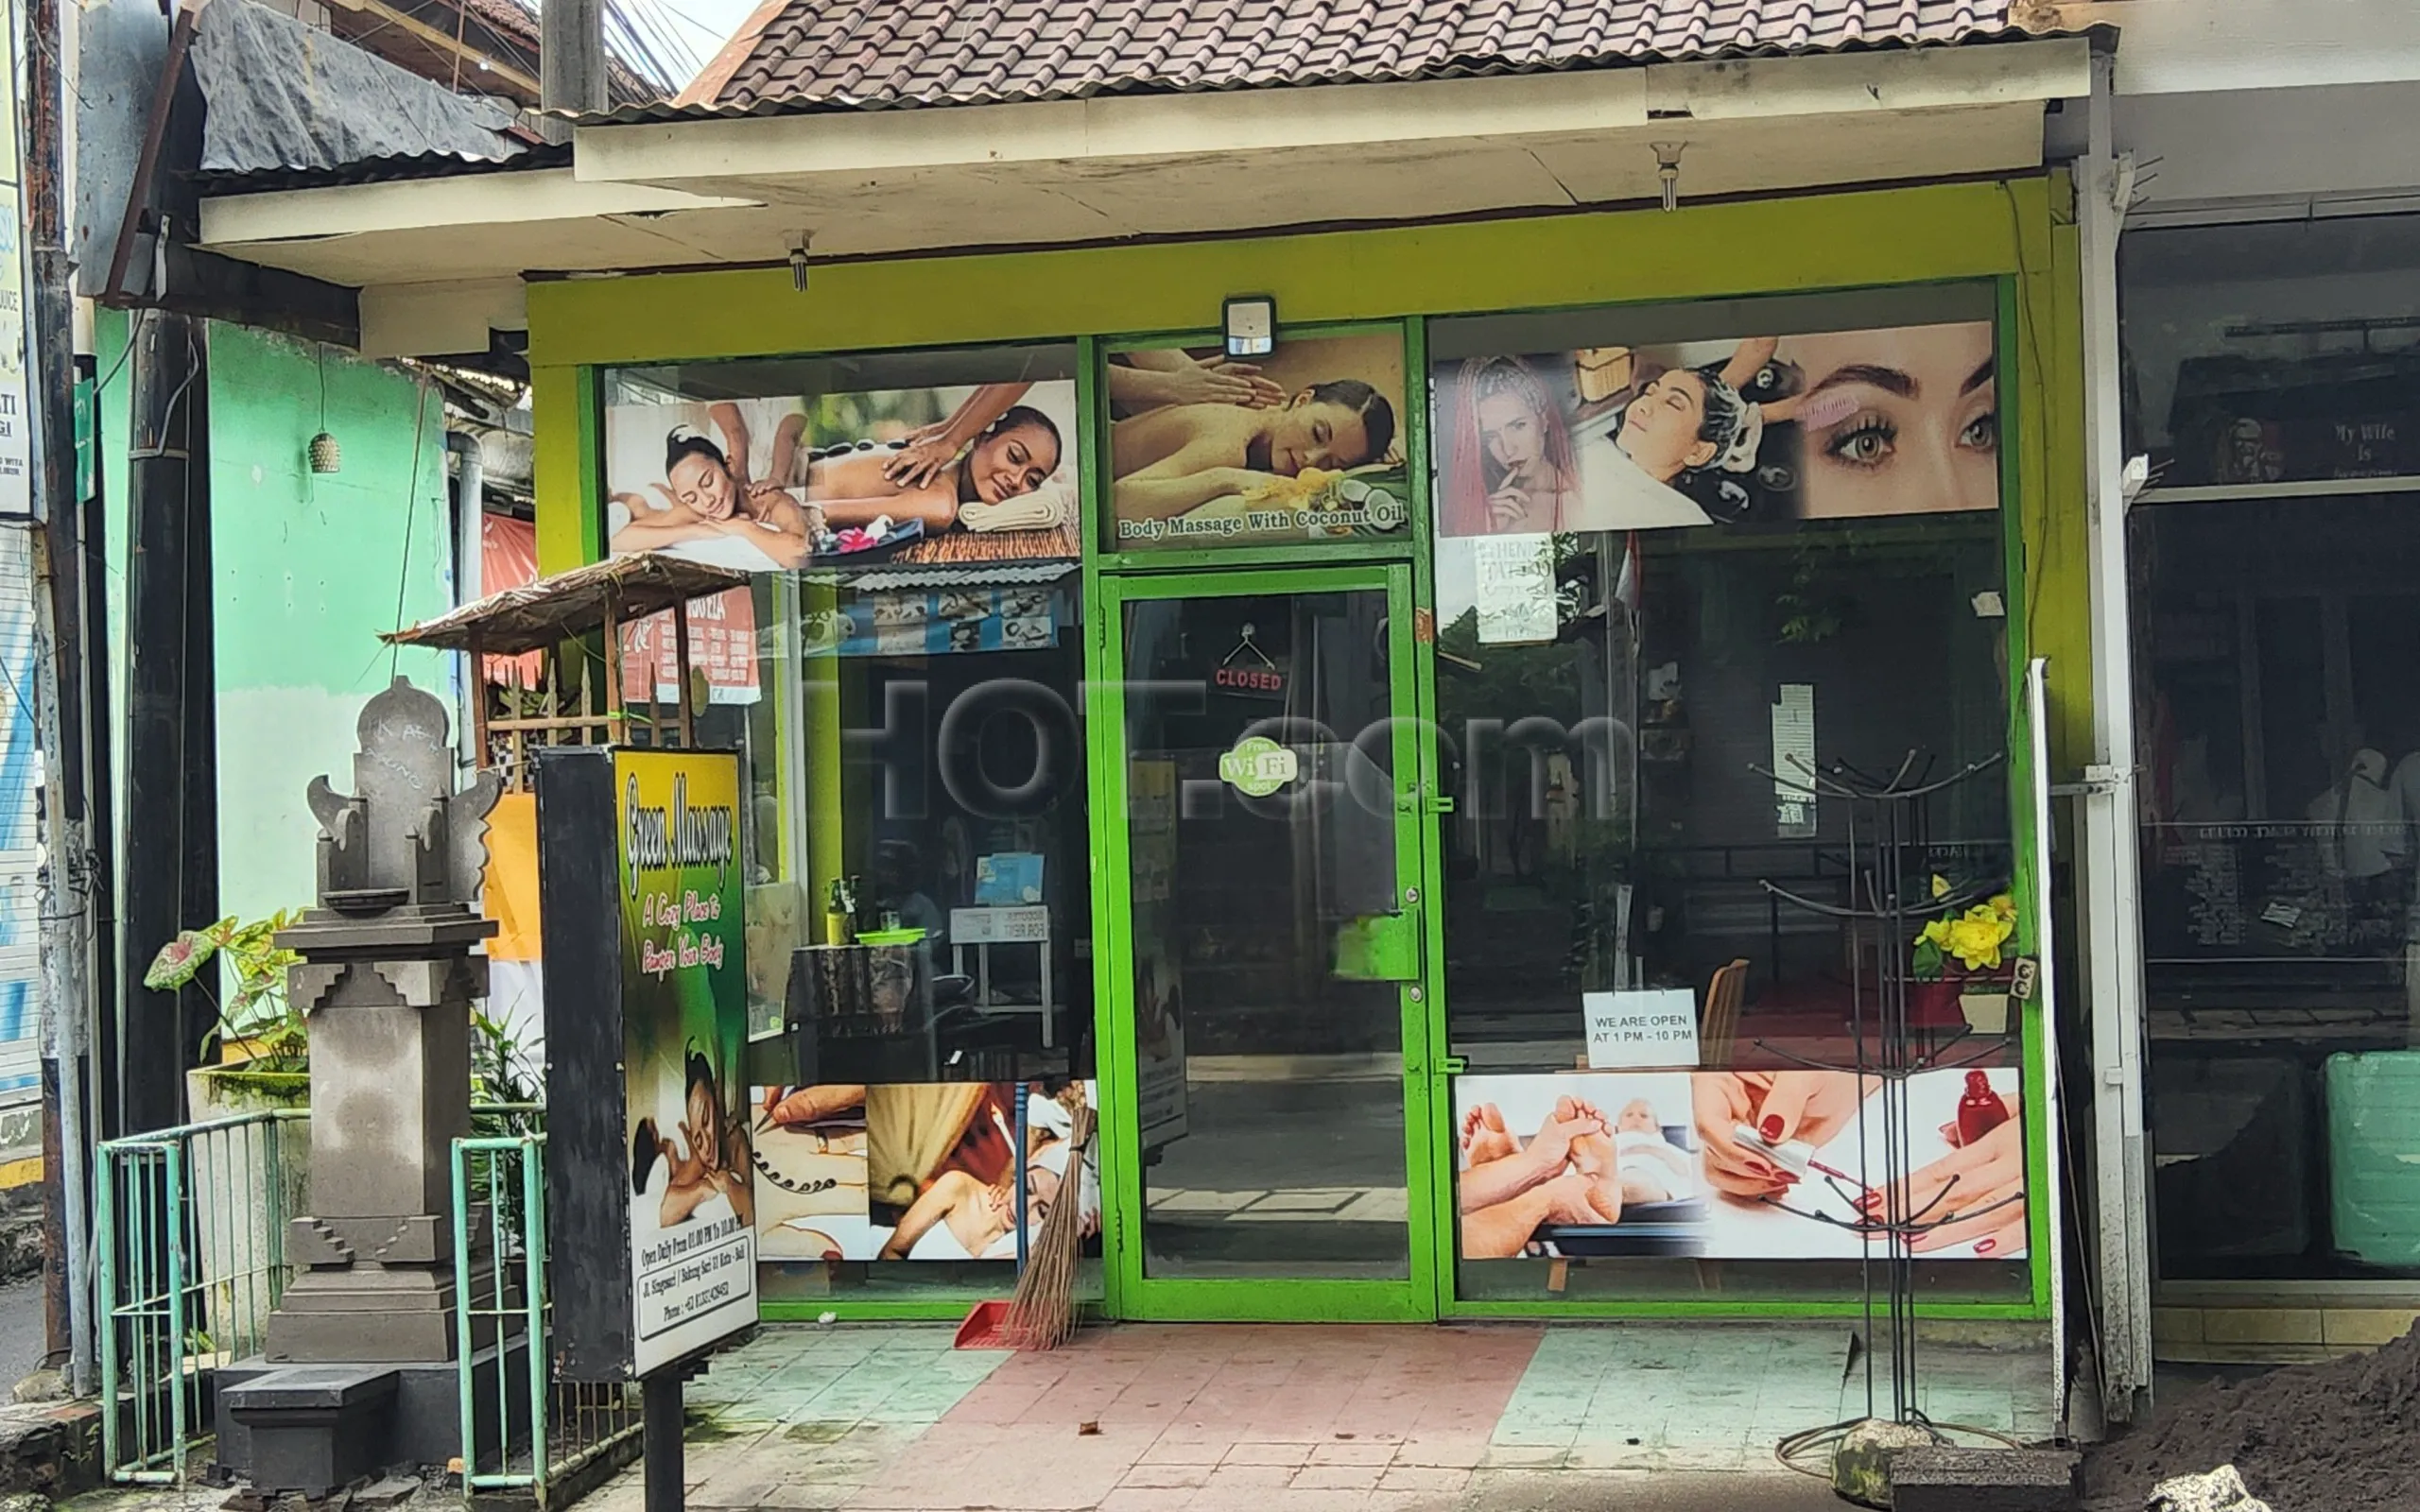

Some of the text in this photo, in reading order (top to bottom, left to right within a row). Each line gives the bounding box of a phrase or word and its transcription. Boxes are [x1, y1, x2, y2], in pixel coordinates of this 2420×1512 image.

[1120, 505, 1404, 541] Body Massage With Coconut Oil
[1216, 668, 1282, 691] CLOSED
[626, 771, 733, 901] Green Massage
[643, 893, 654, 928] A
[656, 892, 681, 931] Cozy
[683, 889, 709, 923] Place
[700, 933, 724, 971] Body
[1593, 1032, 1610, 1043] AT
[1613, 1032, 1619, 1041] 1
[1624, 1031, 1644, 1041] PM
[1655, 1030, 1669, 1040] 10
[1672, 1029, 1692, 1040] PM
[1595, 1015, 1687, 1028] WE ARE OPEN
